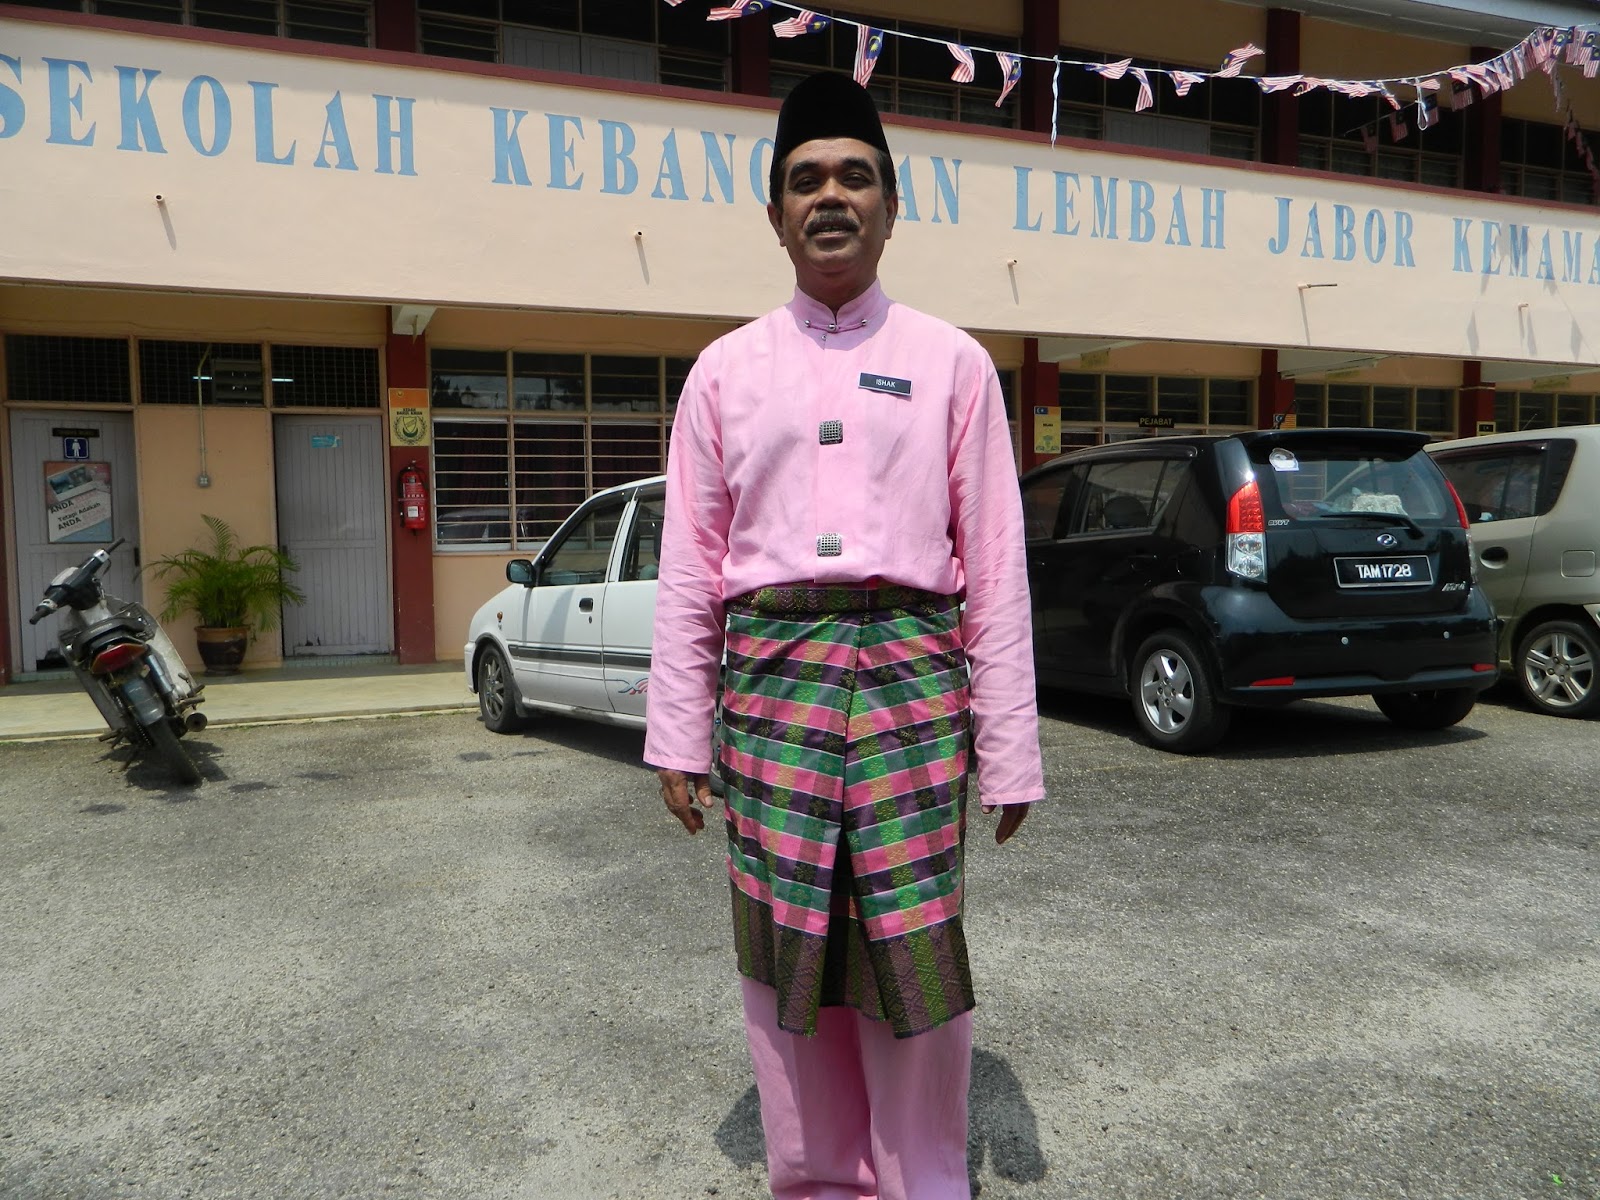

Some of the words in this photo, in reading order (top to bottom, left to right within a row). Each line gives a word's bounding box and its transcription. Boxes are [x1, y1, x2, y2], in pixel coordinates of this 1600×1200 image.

[0, 53, 418, 177] SEKOLAH
[489, 107, 962, 224] KEBANAN
[1012, 165, 1227, 249] LEMBAH
[1268, 197, 1416, 268] JABOR
[875, 378, 896, 388] ISHAK
[1139, 417, 1173, 426] PEJABAT
[50, 500, 74, 514] ANDA
[79, 502, 101, 514] Adakah
[58, 517, 82, 530] ANDA
